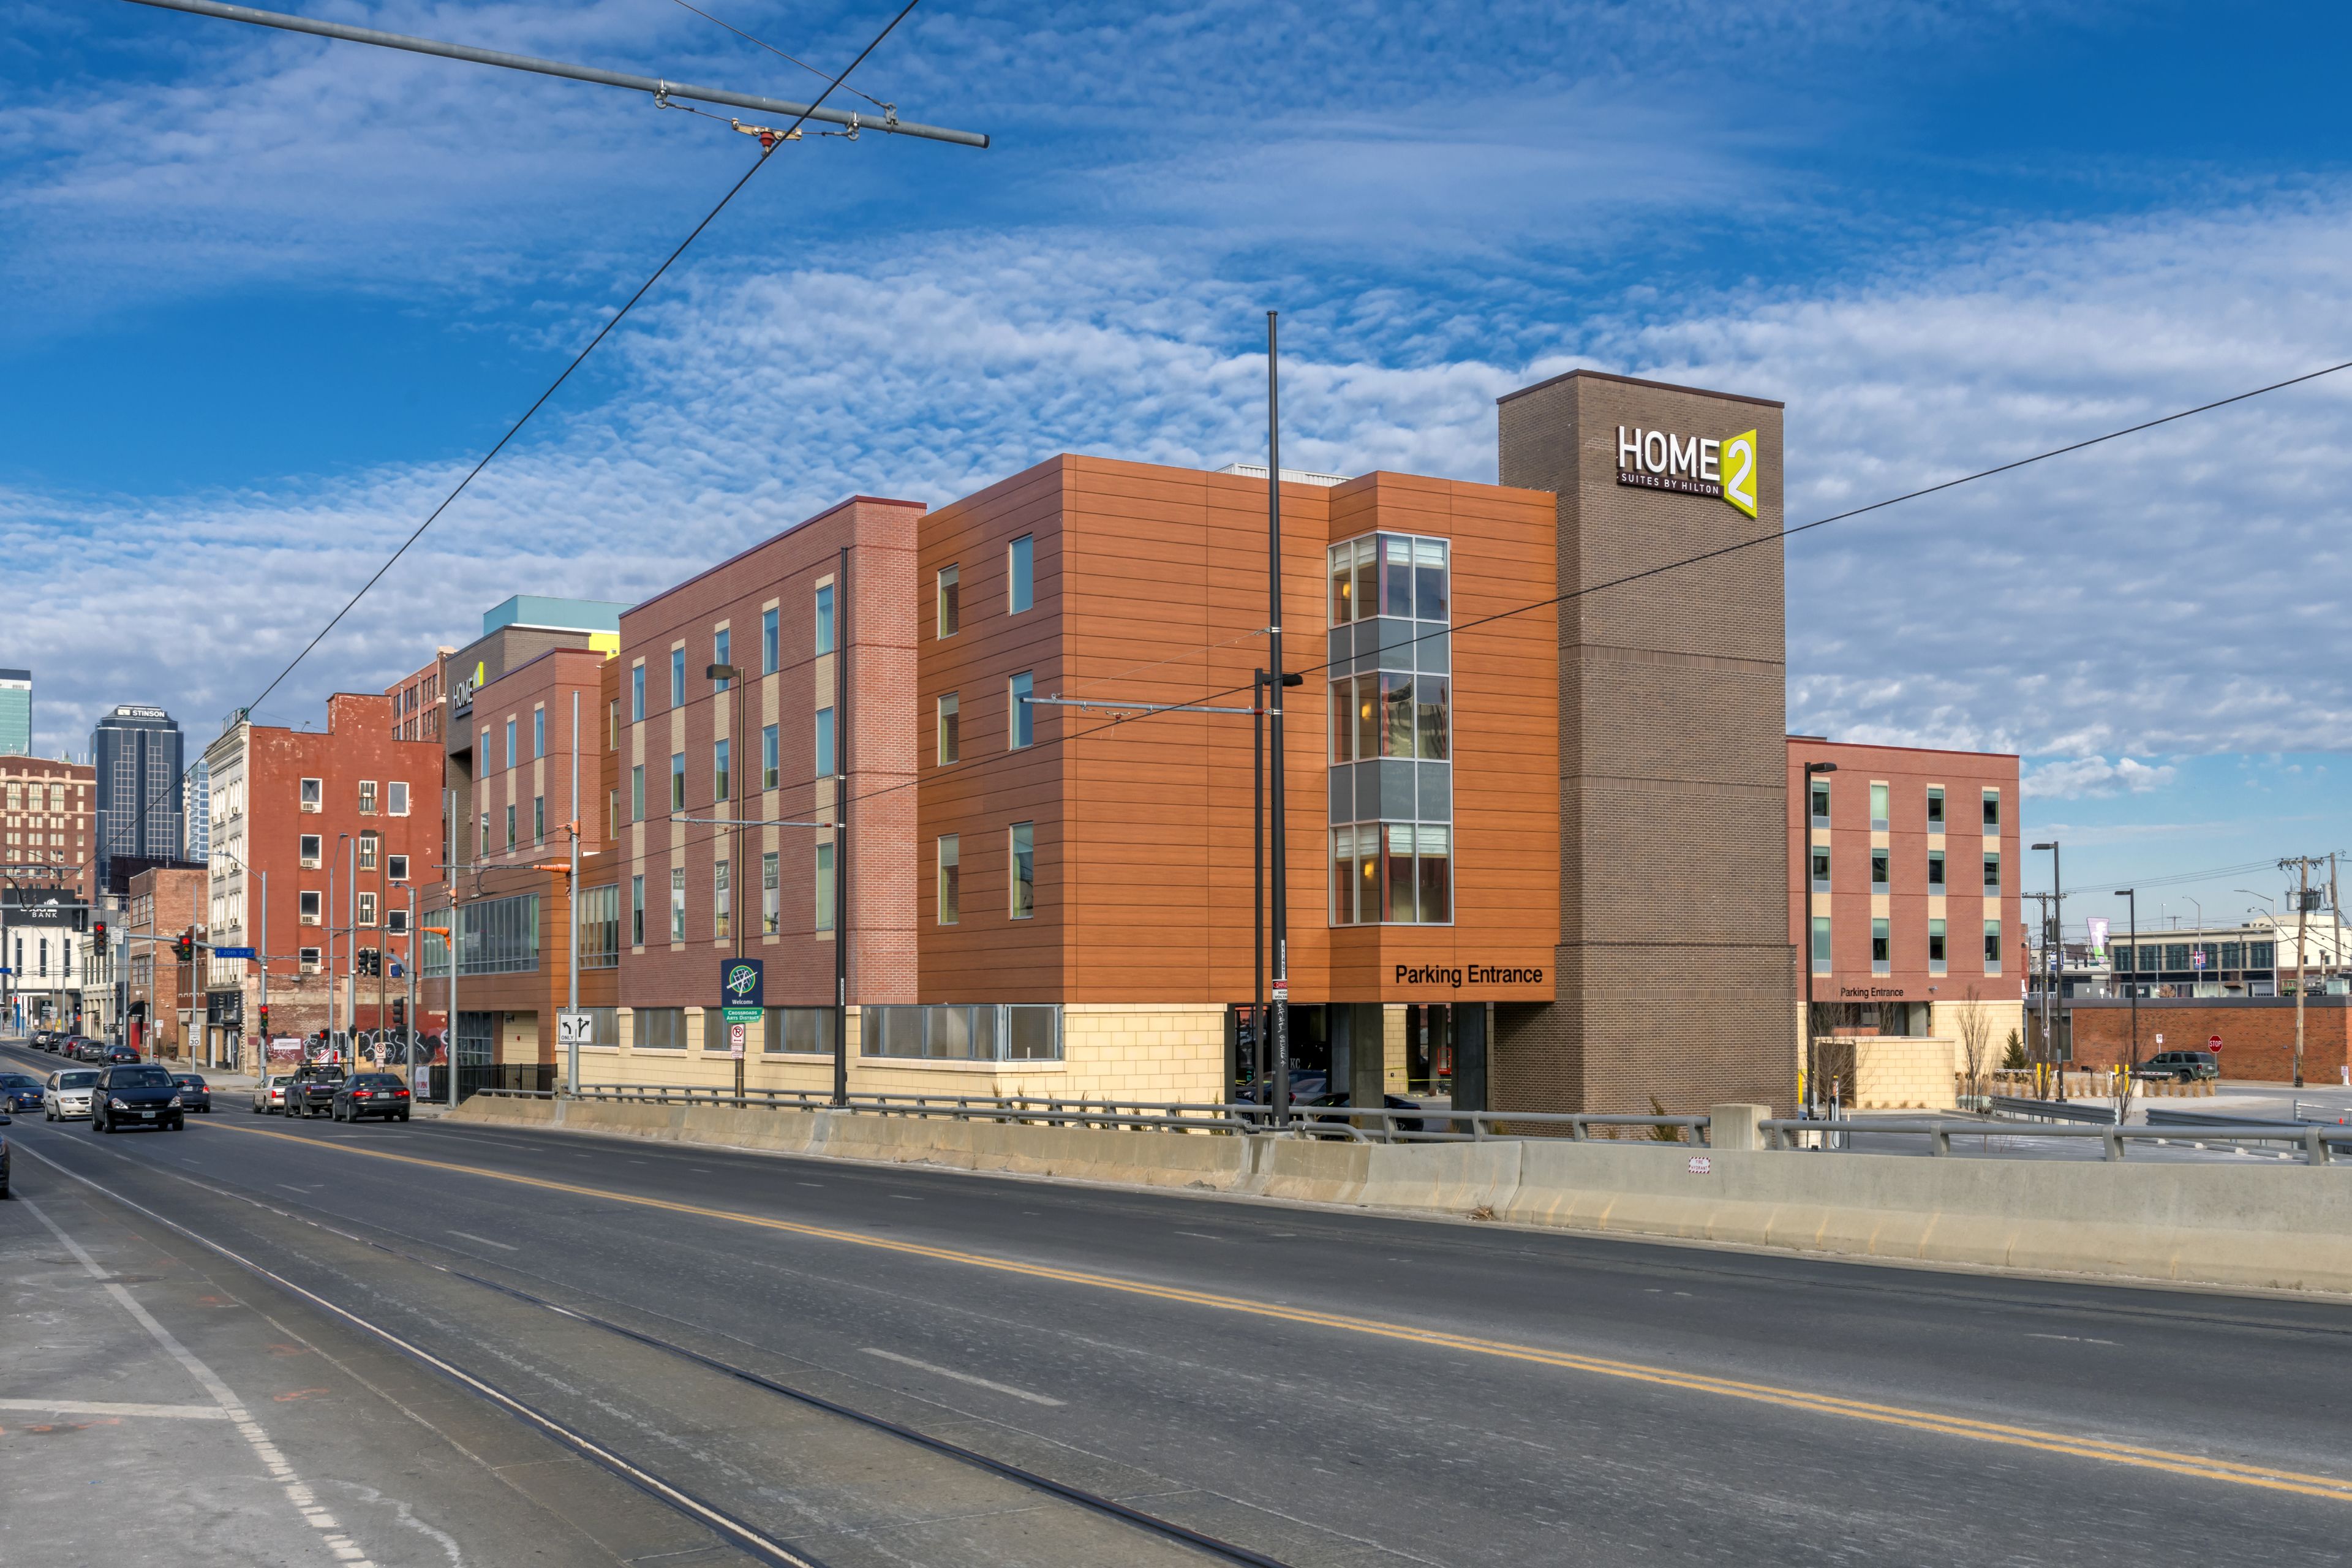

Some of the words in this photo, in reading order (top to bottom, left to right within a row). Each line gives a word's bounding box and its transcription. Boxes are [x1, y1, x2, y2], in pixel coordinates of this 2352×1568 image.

[1618, 425, 1721, 481] HOME
[1727, 439, 1754, 510] 2
[1621, 473, 1659, 486] SUITES
[1664, 479, 1677, 488] BY
[1682, 482, 1719, 494] HILTON
[453, 677, 473, 710] HOME
[1396, 964, 1461, 988] Parking
[1468, 964, 1543, 983] Entrance
[1841, 987, 1869, 999] Parking
[1871, 987, 1904, 997] Entrance
[1289, 1058, 1300, 1069] KC
